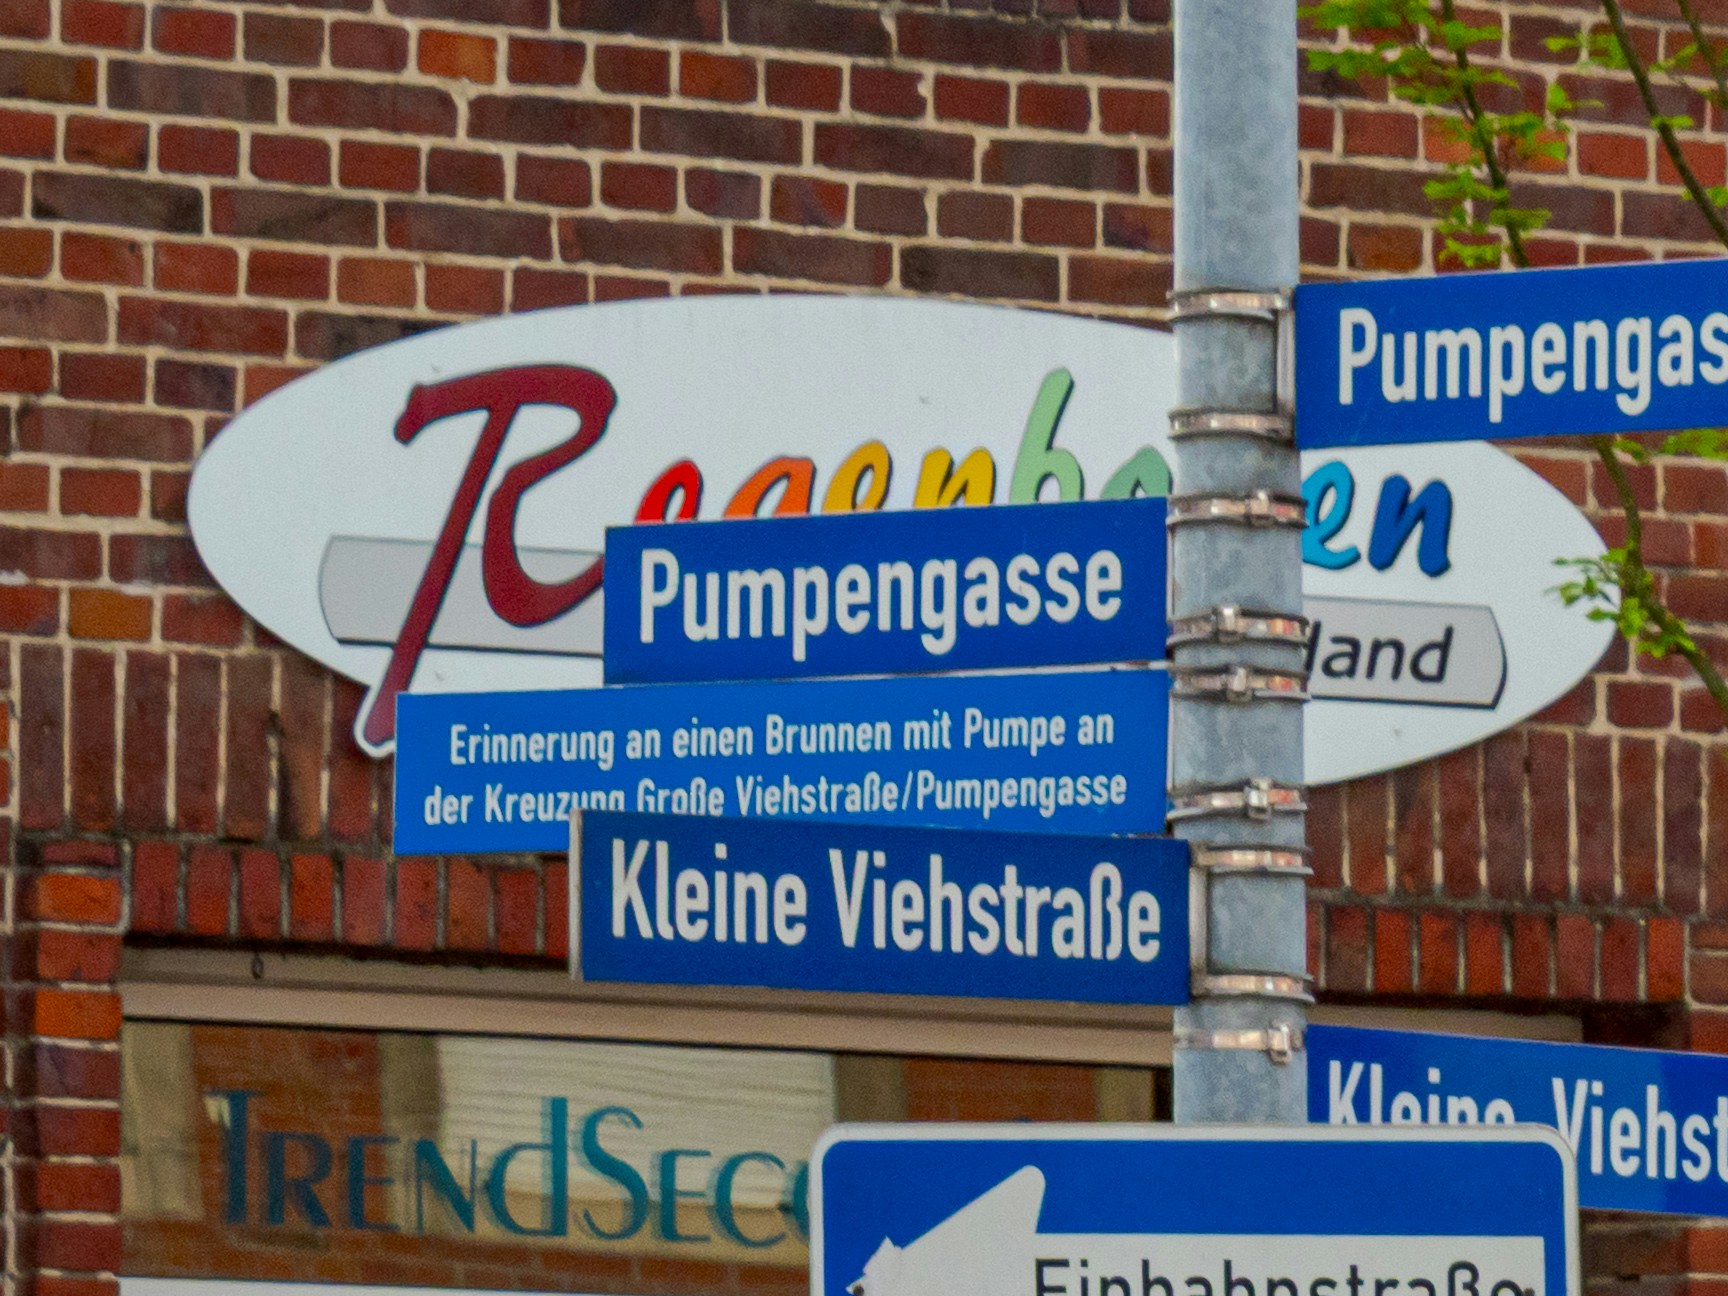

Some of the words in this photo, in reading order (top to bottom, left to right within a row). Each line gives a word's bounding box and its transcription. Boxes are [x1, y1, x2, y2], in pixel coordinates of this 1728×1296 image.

[639, 547, 1123, 661] Pumpengasse
[450, 722, 615, 771] Erinnerung
[626, 728, 661, 759] an
[673, 716, 754, 757] einen
[765, 713, 892, 755] Brunnen
[904, 710, 952, 751] mit
[963, 707, 1066, 757] Pumpe
[1077, 713, 1114, 746] an
[424, 784, 473, 826] der
[637, 776, 725, 817] Große
[611, 837, 808, 947] Kleine
[828, 847, 1162, 964] Viehstraße
